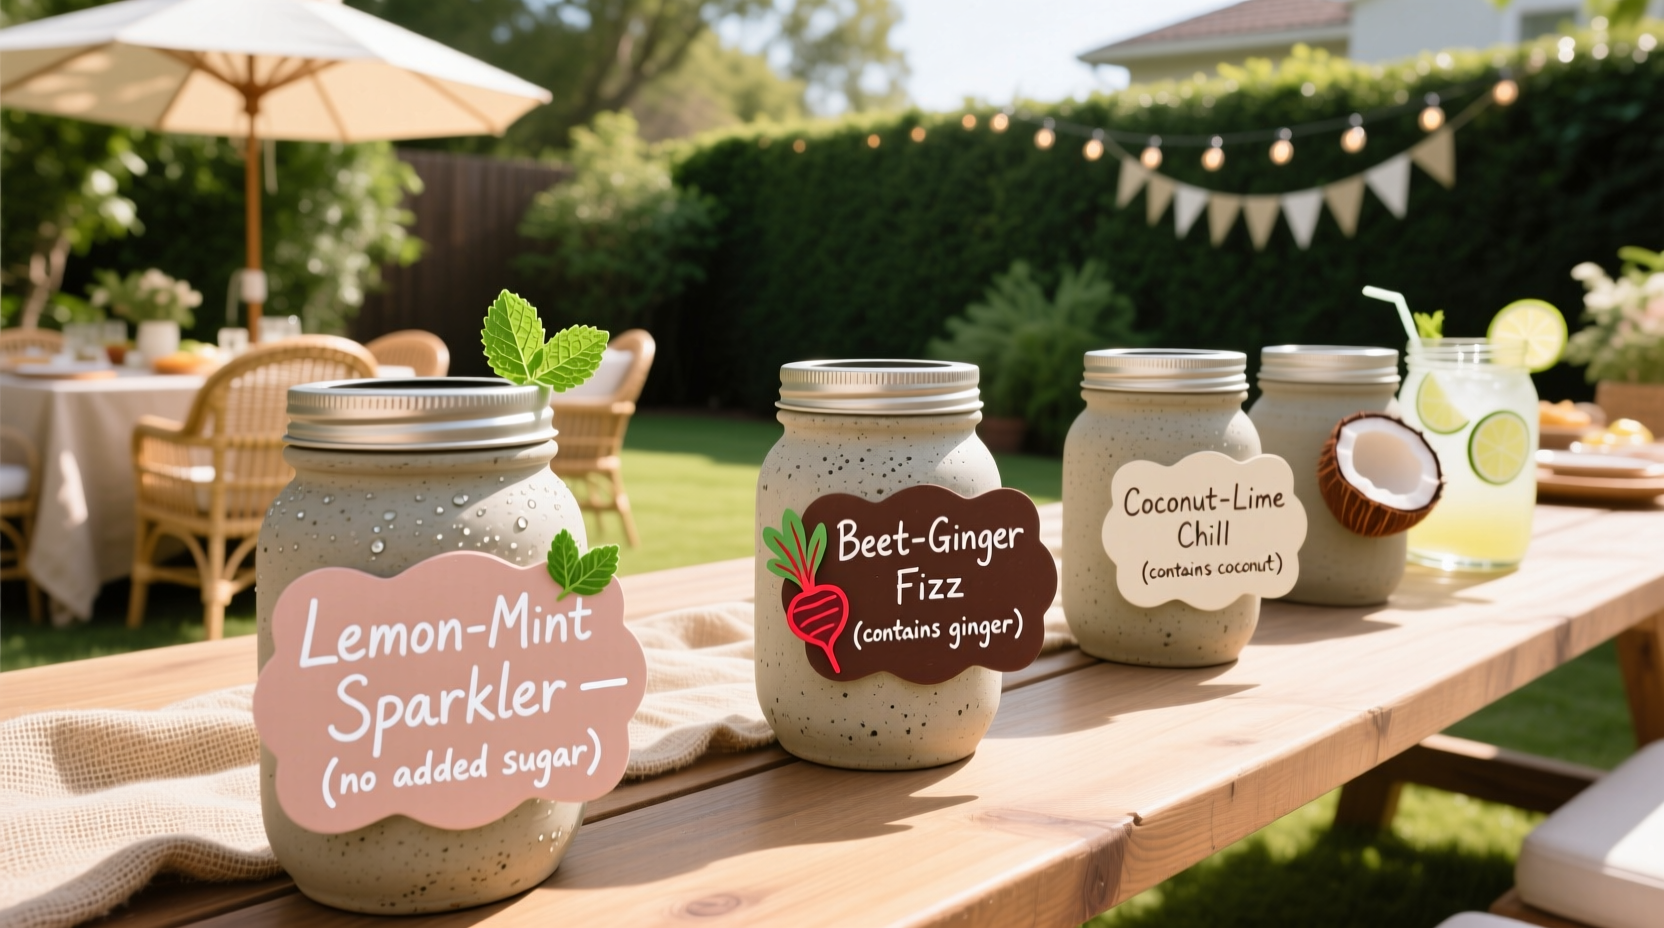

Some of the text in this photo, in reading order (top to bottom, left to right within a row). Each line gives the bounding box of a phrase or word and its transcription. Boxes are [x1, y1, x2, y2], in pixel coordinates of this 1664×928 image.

[1123, 482, 1286, 517] Coconut-Lime
[836, 515, 1025, 567] Beet-Ginger
[1177, 519, 1230, 549] Chill
[895, 566, 965, 605] Fizz
[1141, 551, 1284, 586] (contains coconut)
[298, 591, 593, 669] Lemon-Mint
[853, 607, 1024, 651] (contains ginger)
[326, 659, 568, 759] Sparkler
[321, 726, 603, 810] (no added sugar)
